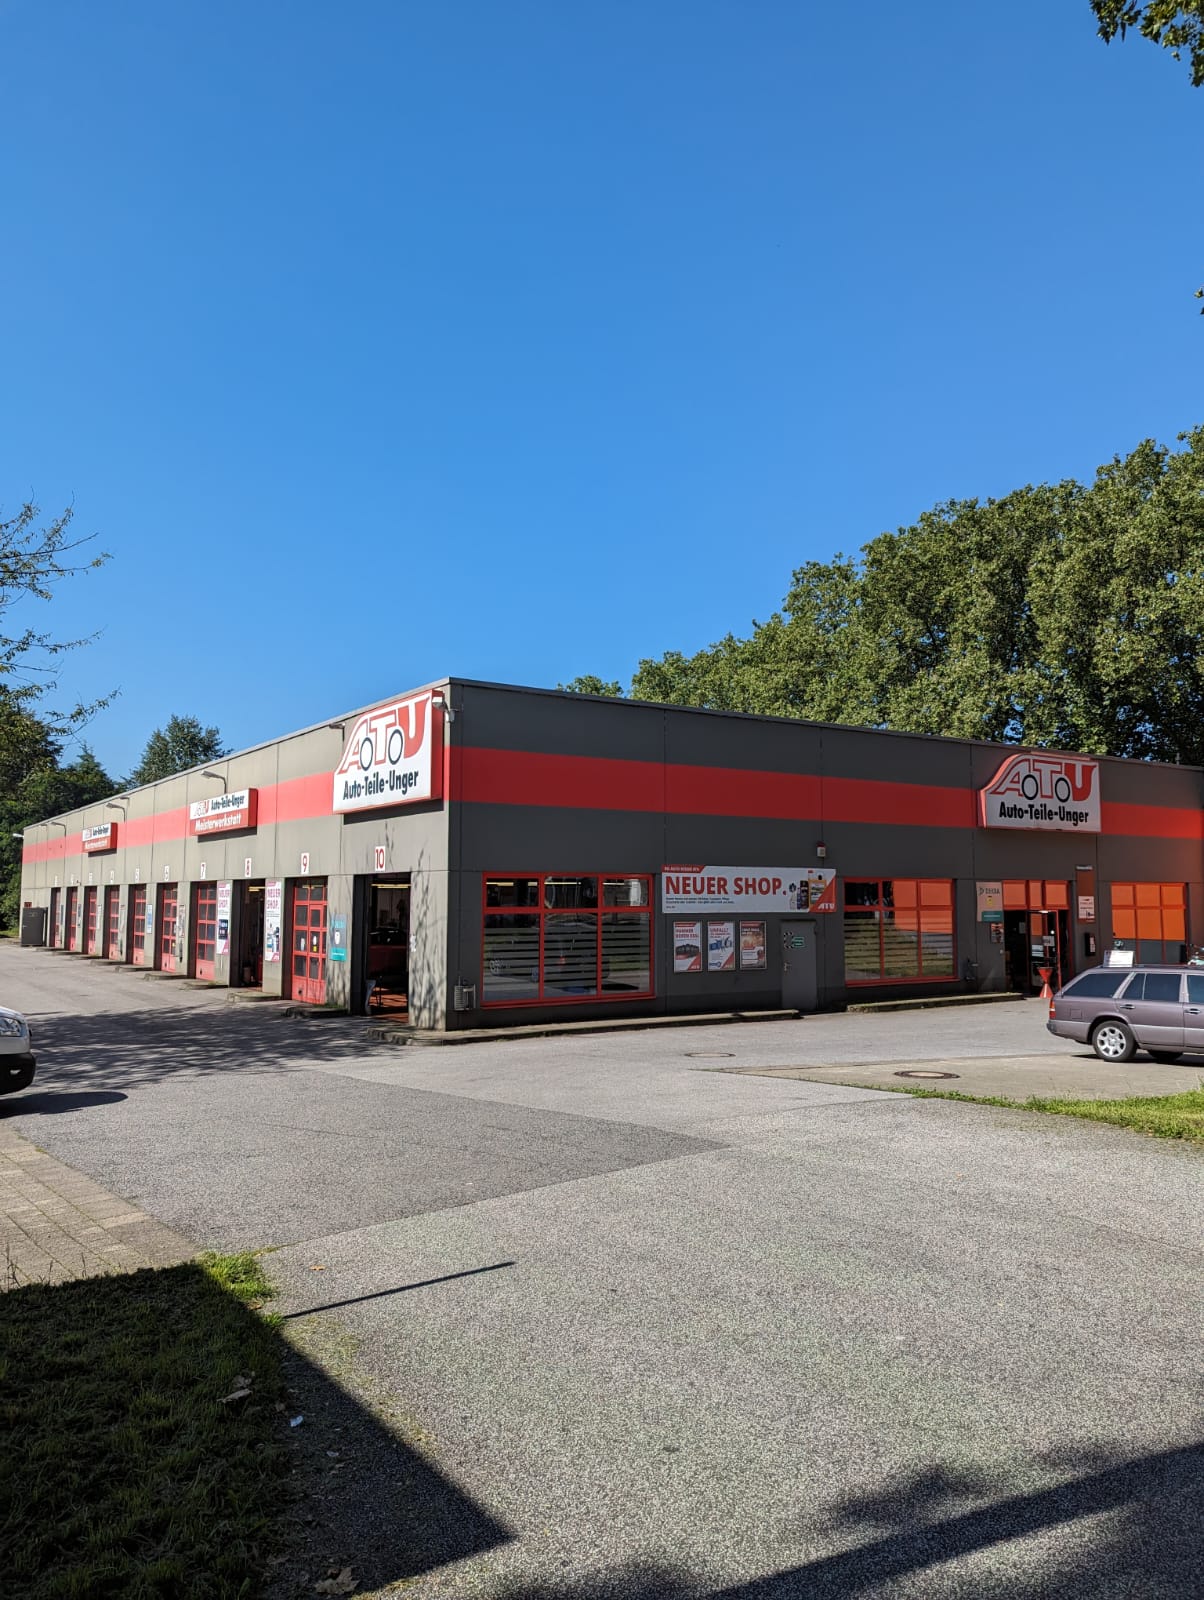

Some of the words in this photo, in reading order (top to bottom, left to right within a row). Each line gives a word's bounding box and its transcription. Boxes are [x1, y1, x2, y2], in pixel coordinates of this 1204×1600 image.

[343, 770, 418, 800] Auto-Teile-Unger
[999, 801, 1089, 826] Auto-Teile-Unger
[302, 855, 308, 872] 9
[375, 848, 384, 869] 10
[665, 876, 728, 895] NEUER
[733, 877, 787, 896] SHOP.
